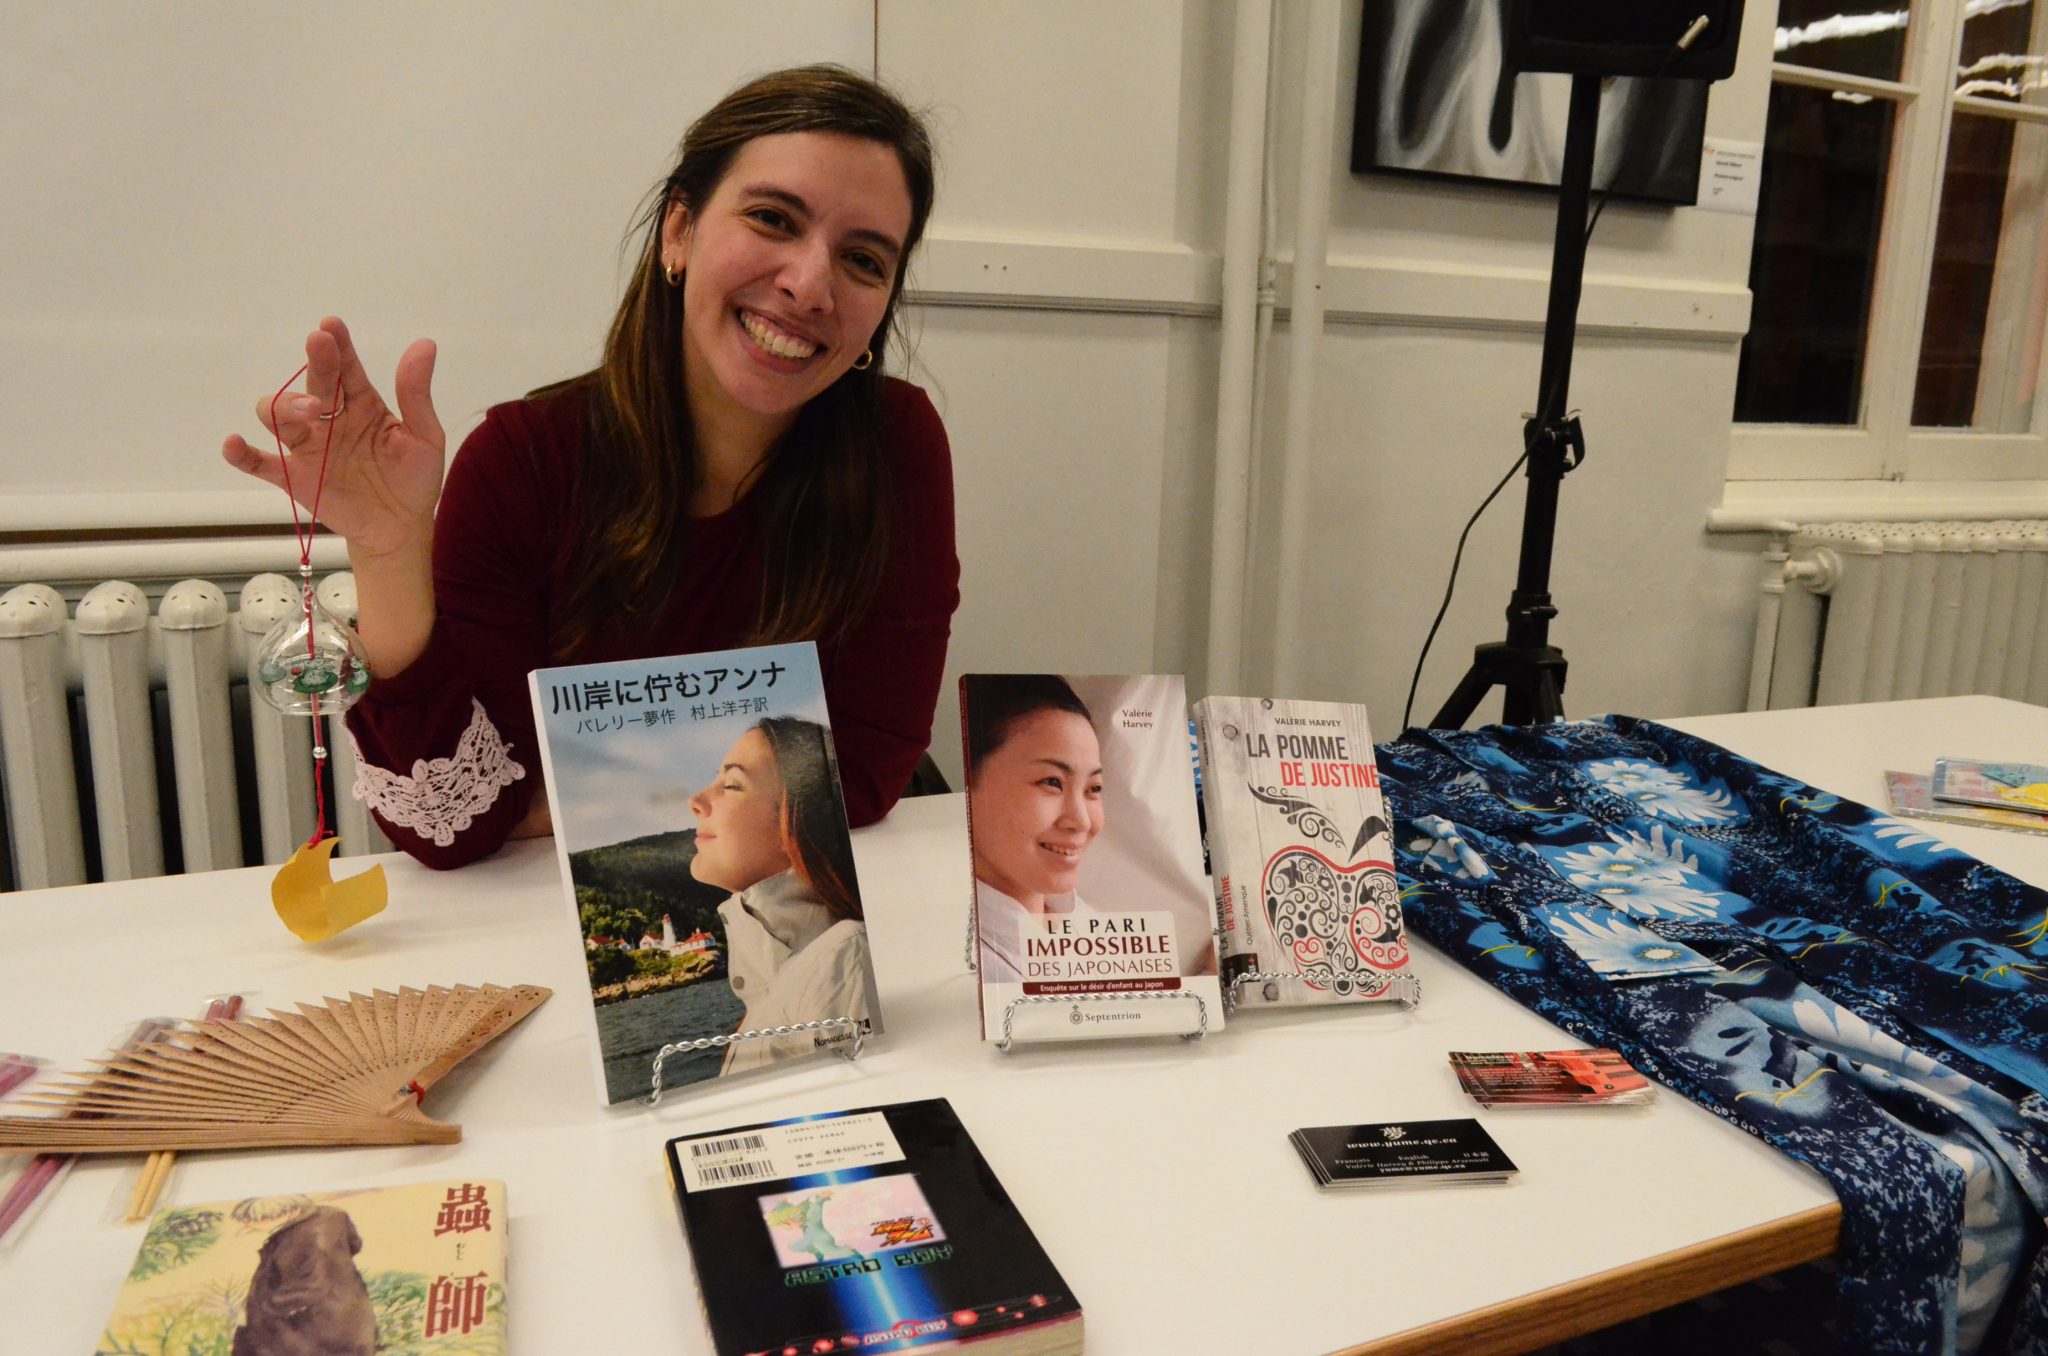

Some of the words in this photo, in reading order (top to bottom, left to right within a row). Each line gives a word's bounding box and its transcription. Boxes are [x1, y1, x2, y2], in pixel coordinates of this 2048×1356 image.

[552, 661, 786, 715] 川岸に佇むアンナ
[577, 708, 676, 734] バレリー夢作
[690, 696, 769, 721] 村上洋子訳
[1308, 719, 1341, 727] HARVEY
[1123, 720, 1153, 730] Harvey
[1246, 733, 1271, 758] LA
[1276, 734, 1349, 760] POMME
[1280, 762, 1304, 787] DE
[1311, 762, 1381, 788] JUSTINE
[1221, 874, 1235, 915] JUSTINE
[1216, 896, 1226, 933] POMME
[1048, 920, 1072, 935] LE
[1089, 918, 1146, 934] PARI
[1225, 917, 1236, 932] DE
[1027, 935, 1170, 957] IMPOSSIBLE
[1219, 936, 1228, 950] LA
[1028, 961, 1061, 977] DES
[1068, 958, 1173, 978] JAPONAISES
[1040, 984, 1067, 993] Enquête
[1089, 982, 1105, 990] désir
[1106, 981, 1134, 990] d'enfant
[1085, 1011, 1141, 1023] Septentrion
[1347, 1137, 1458, 1150] www.yume.qc.ca
[1398, 1154, 1430, 1163] English
[785, 1258, 882, 1287] ASTRO
[893, 1244, 953, 1267] BOY
